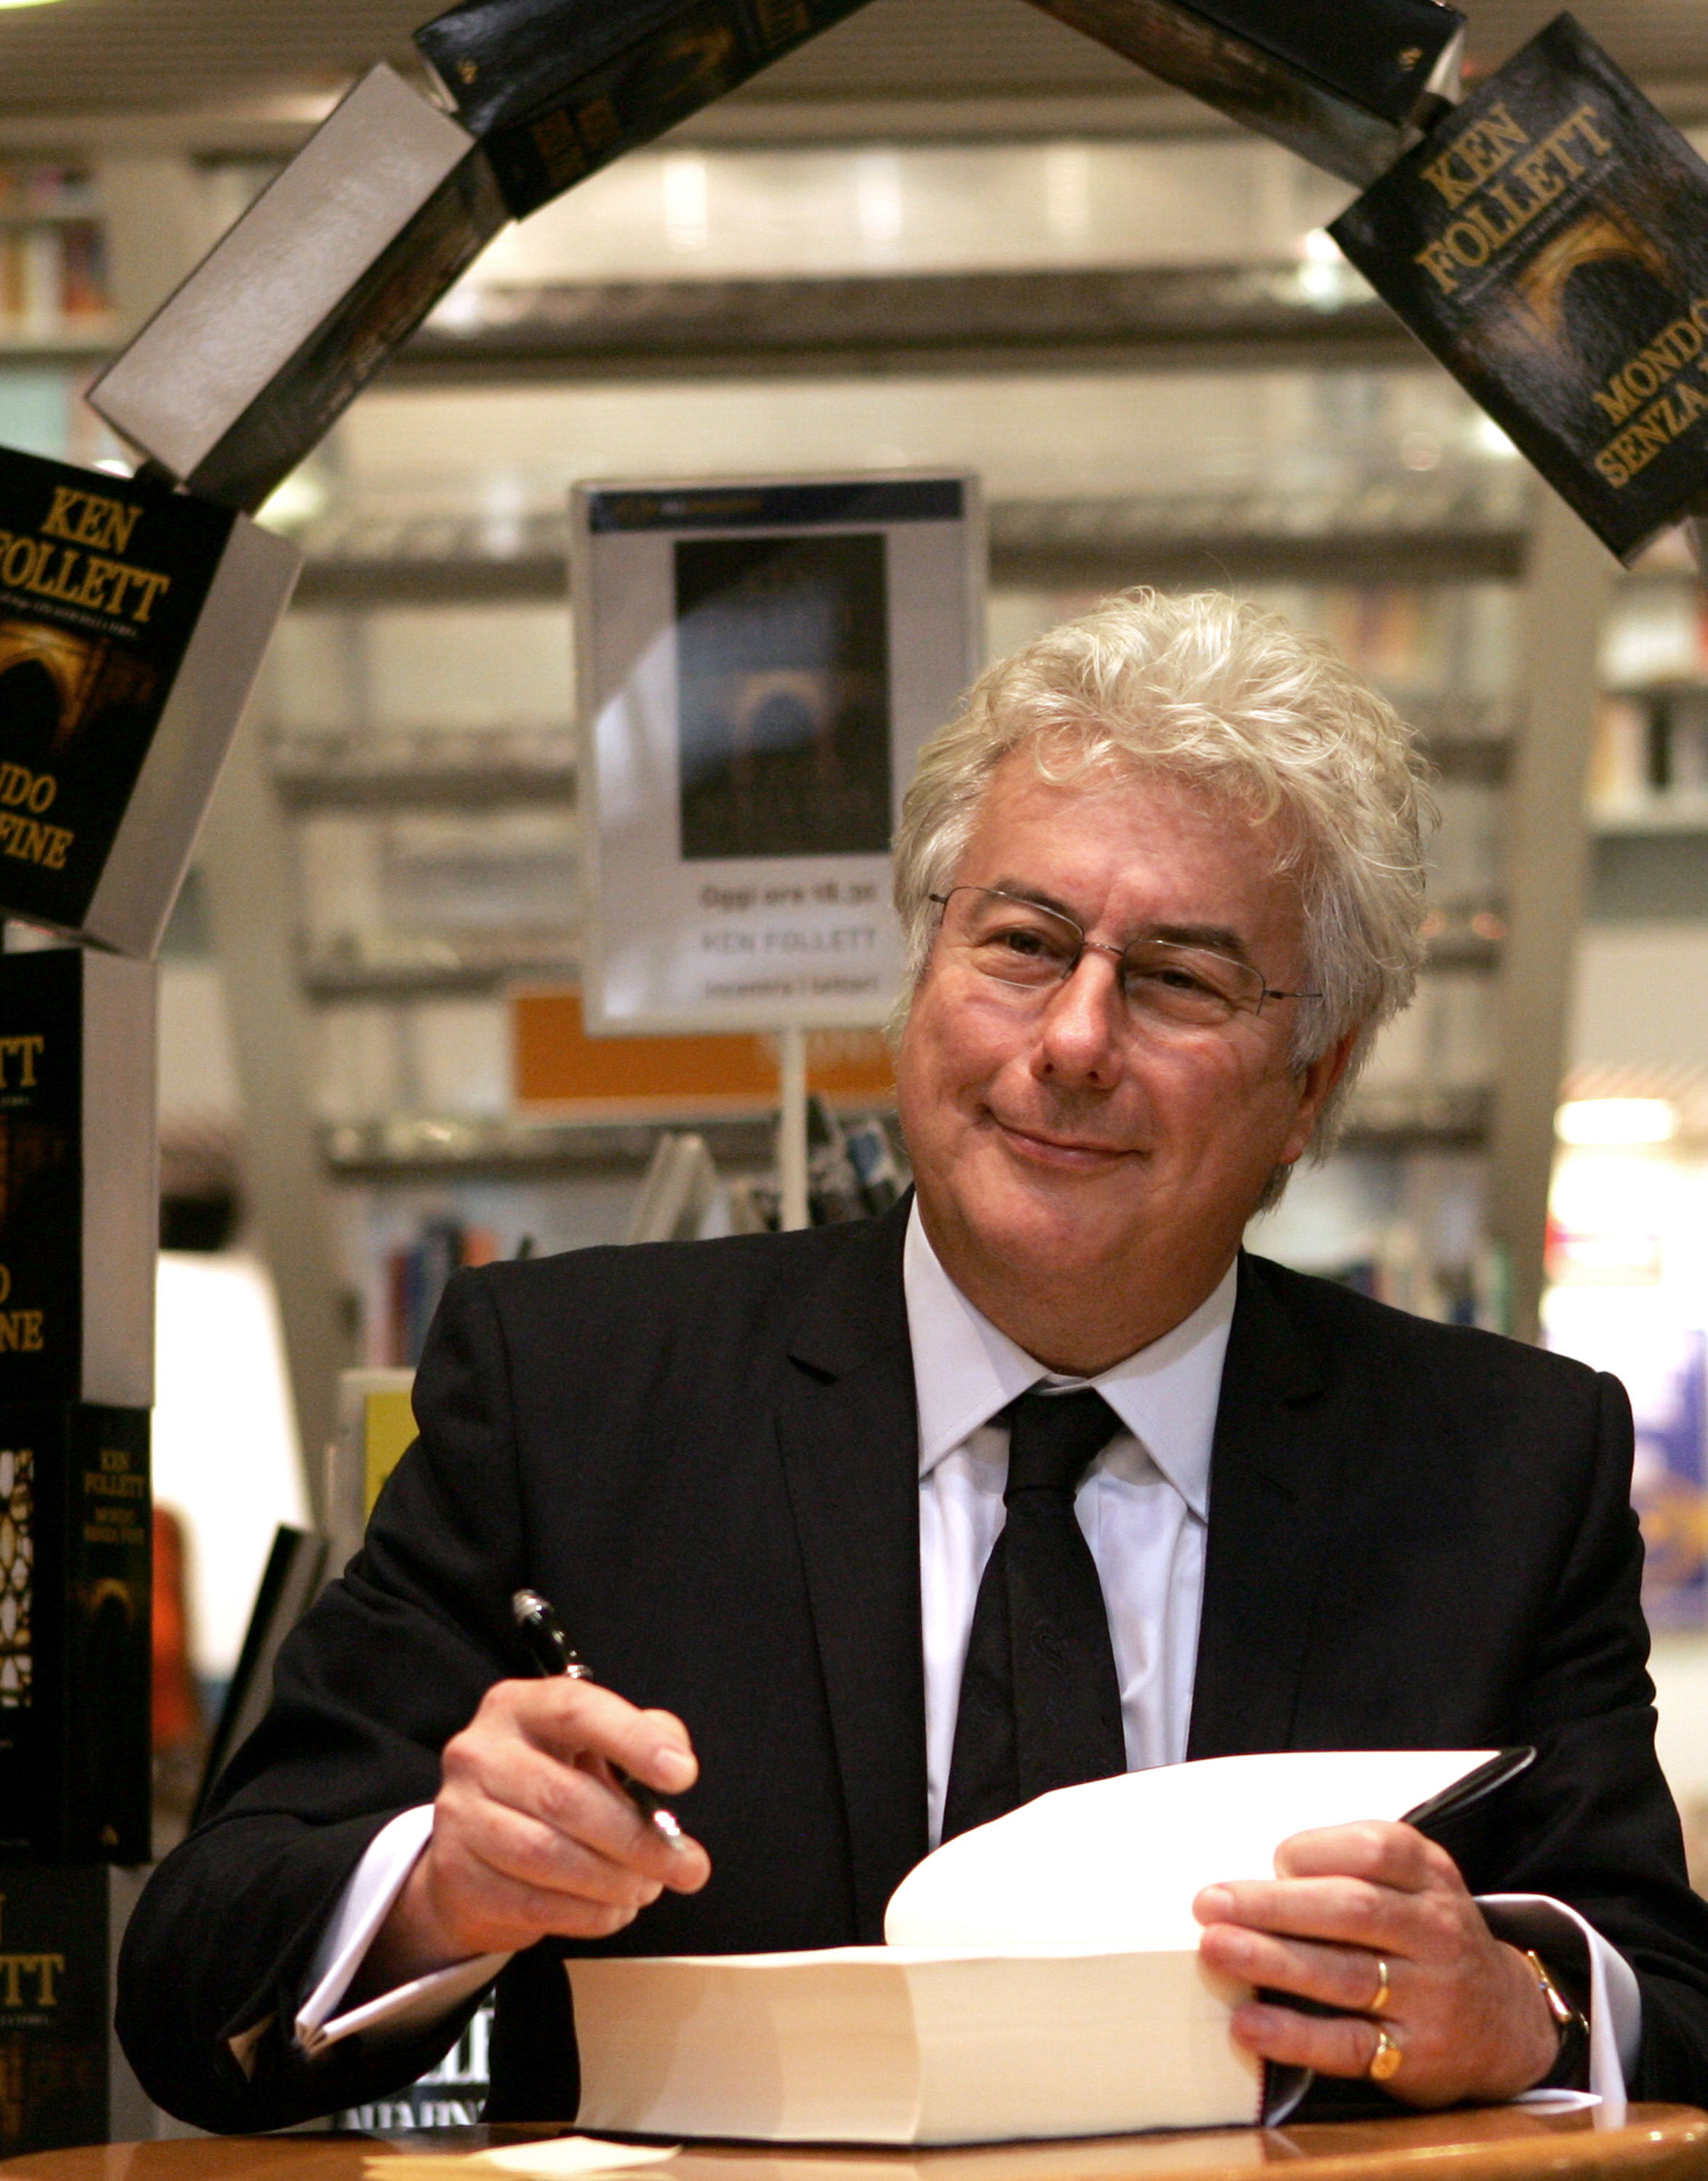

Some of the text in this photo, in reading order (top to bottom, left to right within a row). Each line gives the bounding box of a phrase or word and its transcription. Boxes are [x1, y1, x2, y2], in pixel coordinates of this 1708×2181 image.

[1415, 105, 1612, 294] FOLLETT
[1421, 102, 1530, 209] KEN
[1594, 380, 1708, 489] SENZA
[40, 486, 144, 555] KEN
[764, 927, 875, 952] FOLLETT
